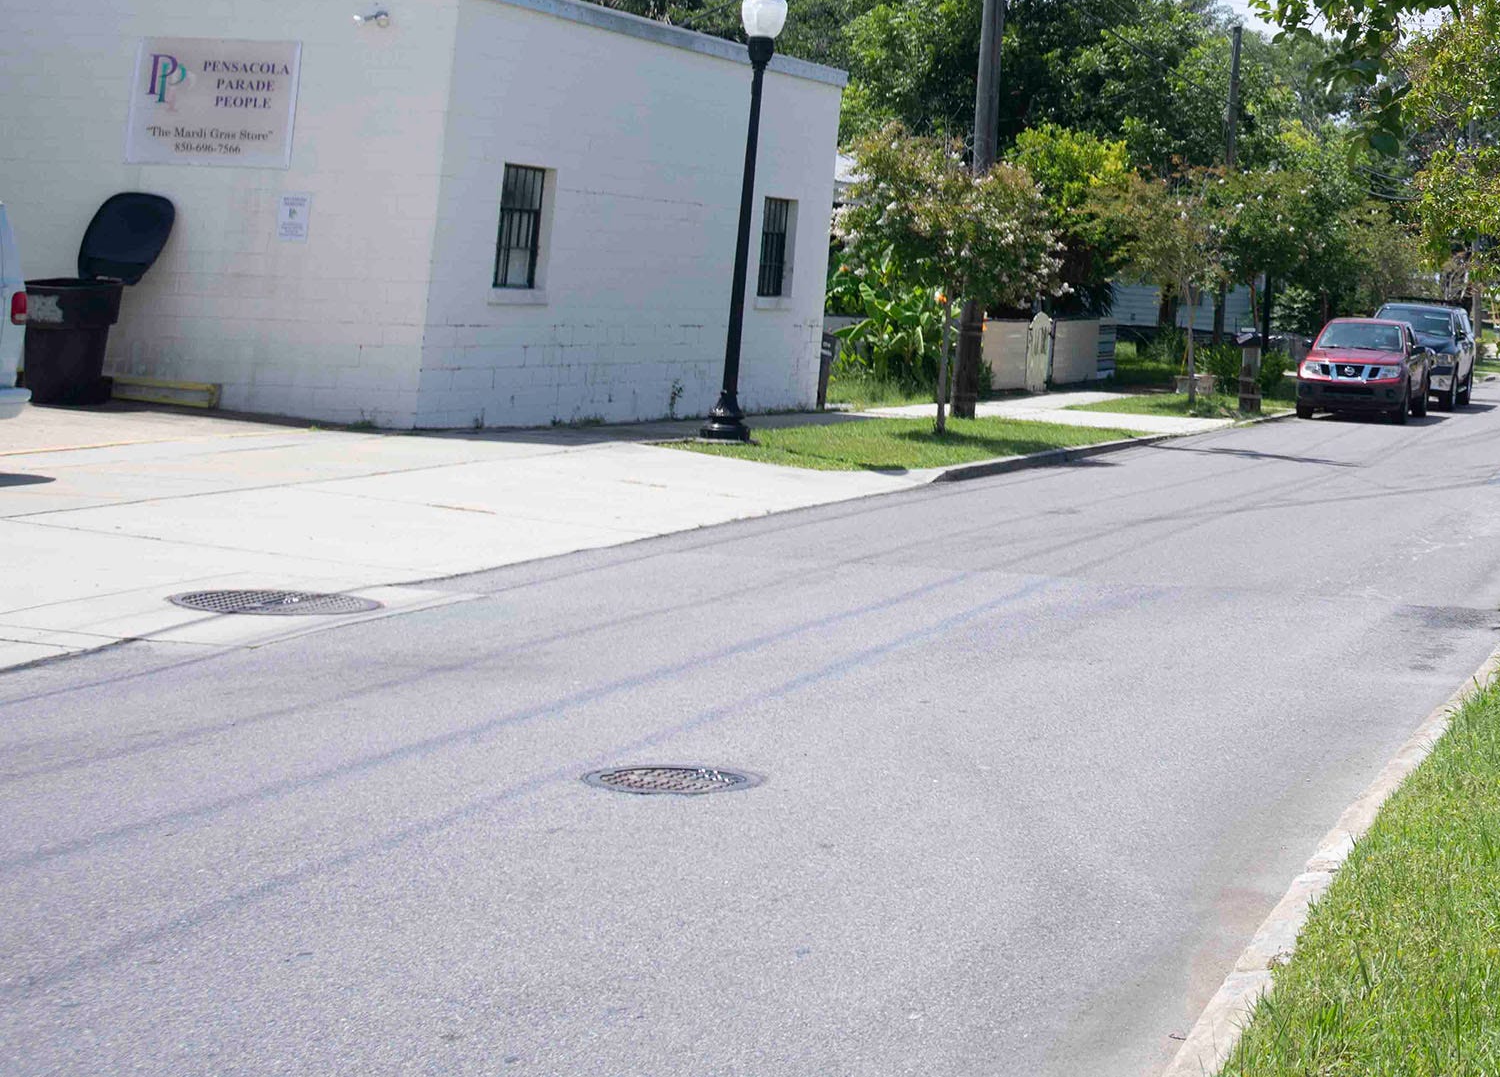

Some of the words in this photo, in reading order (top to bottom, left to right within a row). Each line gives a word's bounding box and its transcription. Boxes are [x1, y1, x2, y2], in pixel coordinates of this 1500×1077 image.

[203, 60, 290, 75] PENSACOLA
[216, 78, 275, 92] PARADE
[214, 95, 272, 109] PEOPLE
[174, 126, 207, 139] Mardi
[210, 128, 237, 140] Gras
